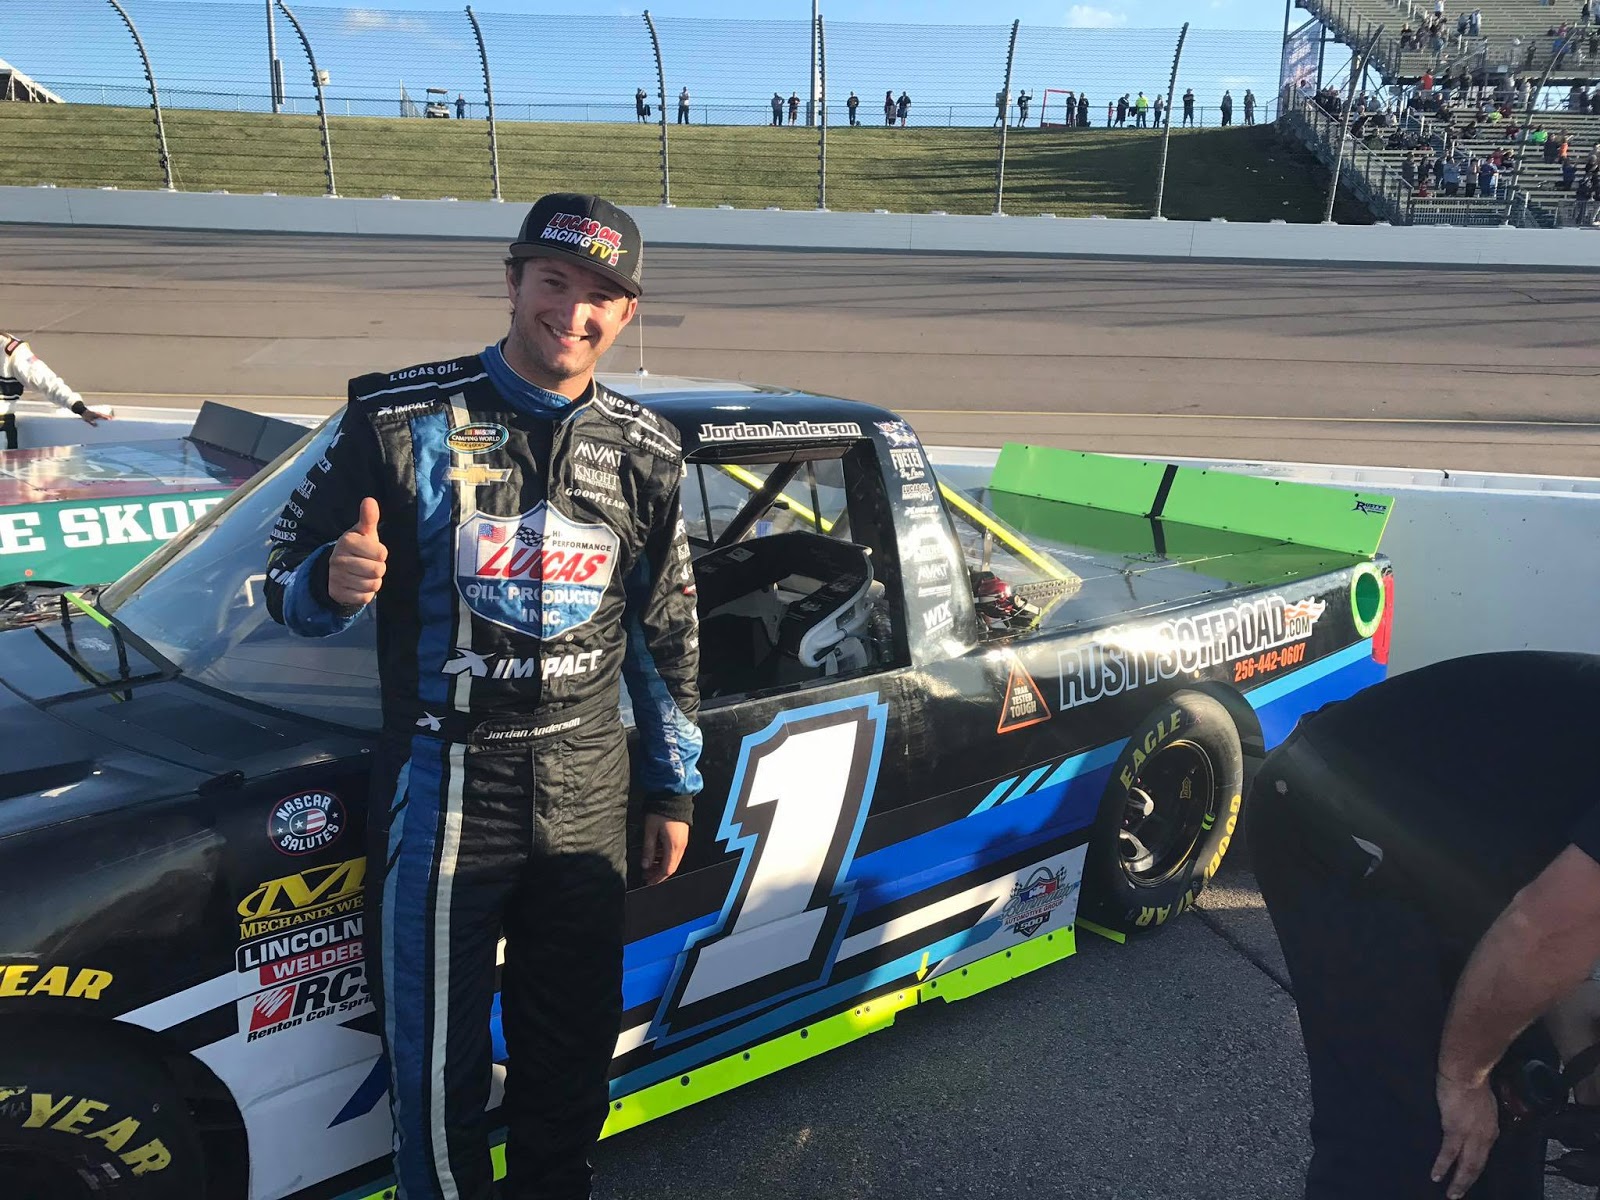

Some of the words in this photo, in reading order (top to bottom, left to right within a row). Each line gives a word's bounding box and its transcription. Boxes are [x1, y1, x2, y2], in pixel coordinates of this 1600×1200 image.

[540, 227, 592, 249] RACING
[547, 212, 601, 237] LUCAS
[597, 226, 622, 247] OIL
[389, 367, 435, 382] LUCAS
[394, 398, 436, 413] IMPACT
[603, 391, 640, 412] LUCAS
[451, 434, 478, 443] CAMPING
[699, 422, 774, 441] Jordan
[773, 421, 862, 437] Anderson
[574, 441, 626, 468] MVMT
[643, 437, 677, 459] IMPACT
[574, 463, 619, 485] KNIGHT
[565, 487, 625, 510] GOODYEAR
[552, 540, 612, 552] PERFORMANCE
[475, 546, 607, 583] LUCAS
[465, 586, 500, 600] OIL
[508, 586, 599, 605] PRODUCTS
[492, 649, 603, 680] IMPACT
[1234, 642, 1306, 682] 256-442-0607
[1010, 700, 1037, 718] TOUGH
[1011, 692, 1033, 706] TESTED
[484, 728, 529, 740] Jordan
[529, 717, 580, 737] Anderson
[1120, 709, 1182, 790] EAGLE
[276, 794, 332, 822] NASCAR
[280, 823, 340, 851] SALUTES
[678, 720, 858, 1007] 1
[239, 907, 334, 941] MECHANIX
[1004, 908, 1043, 926] AUTOMOTIVE
[1043, 898, 1063, 912] GROUP
[1019, 916, 1043, 930] 500
[245, 918, 363, 968] LINCOLN
[0, 965, 113, 1000] EAR
[292, 966, 369, 1017] RC
[247, 1017, 302, 1043] Renton
[306, 1003, 336, 1022] Coil
